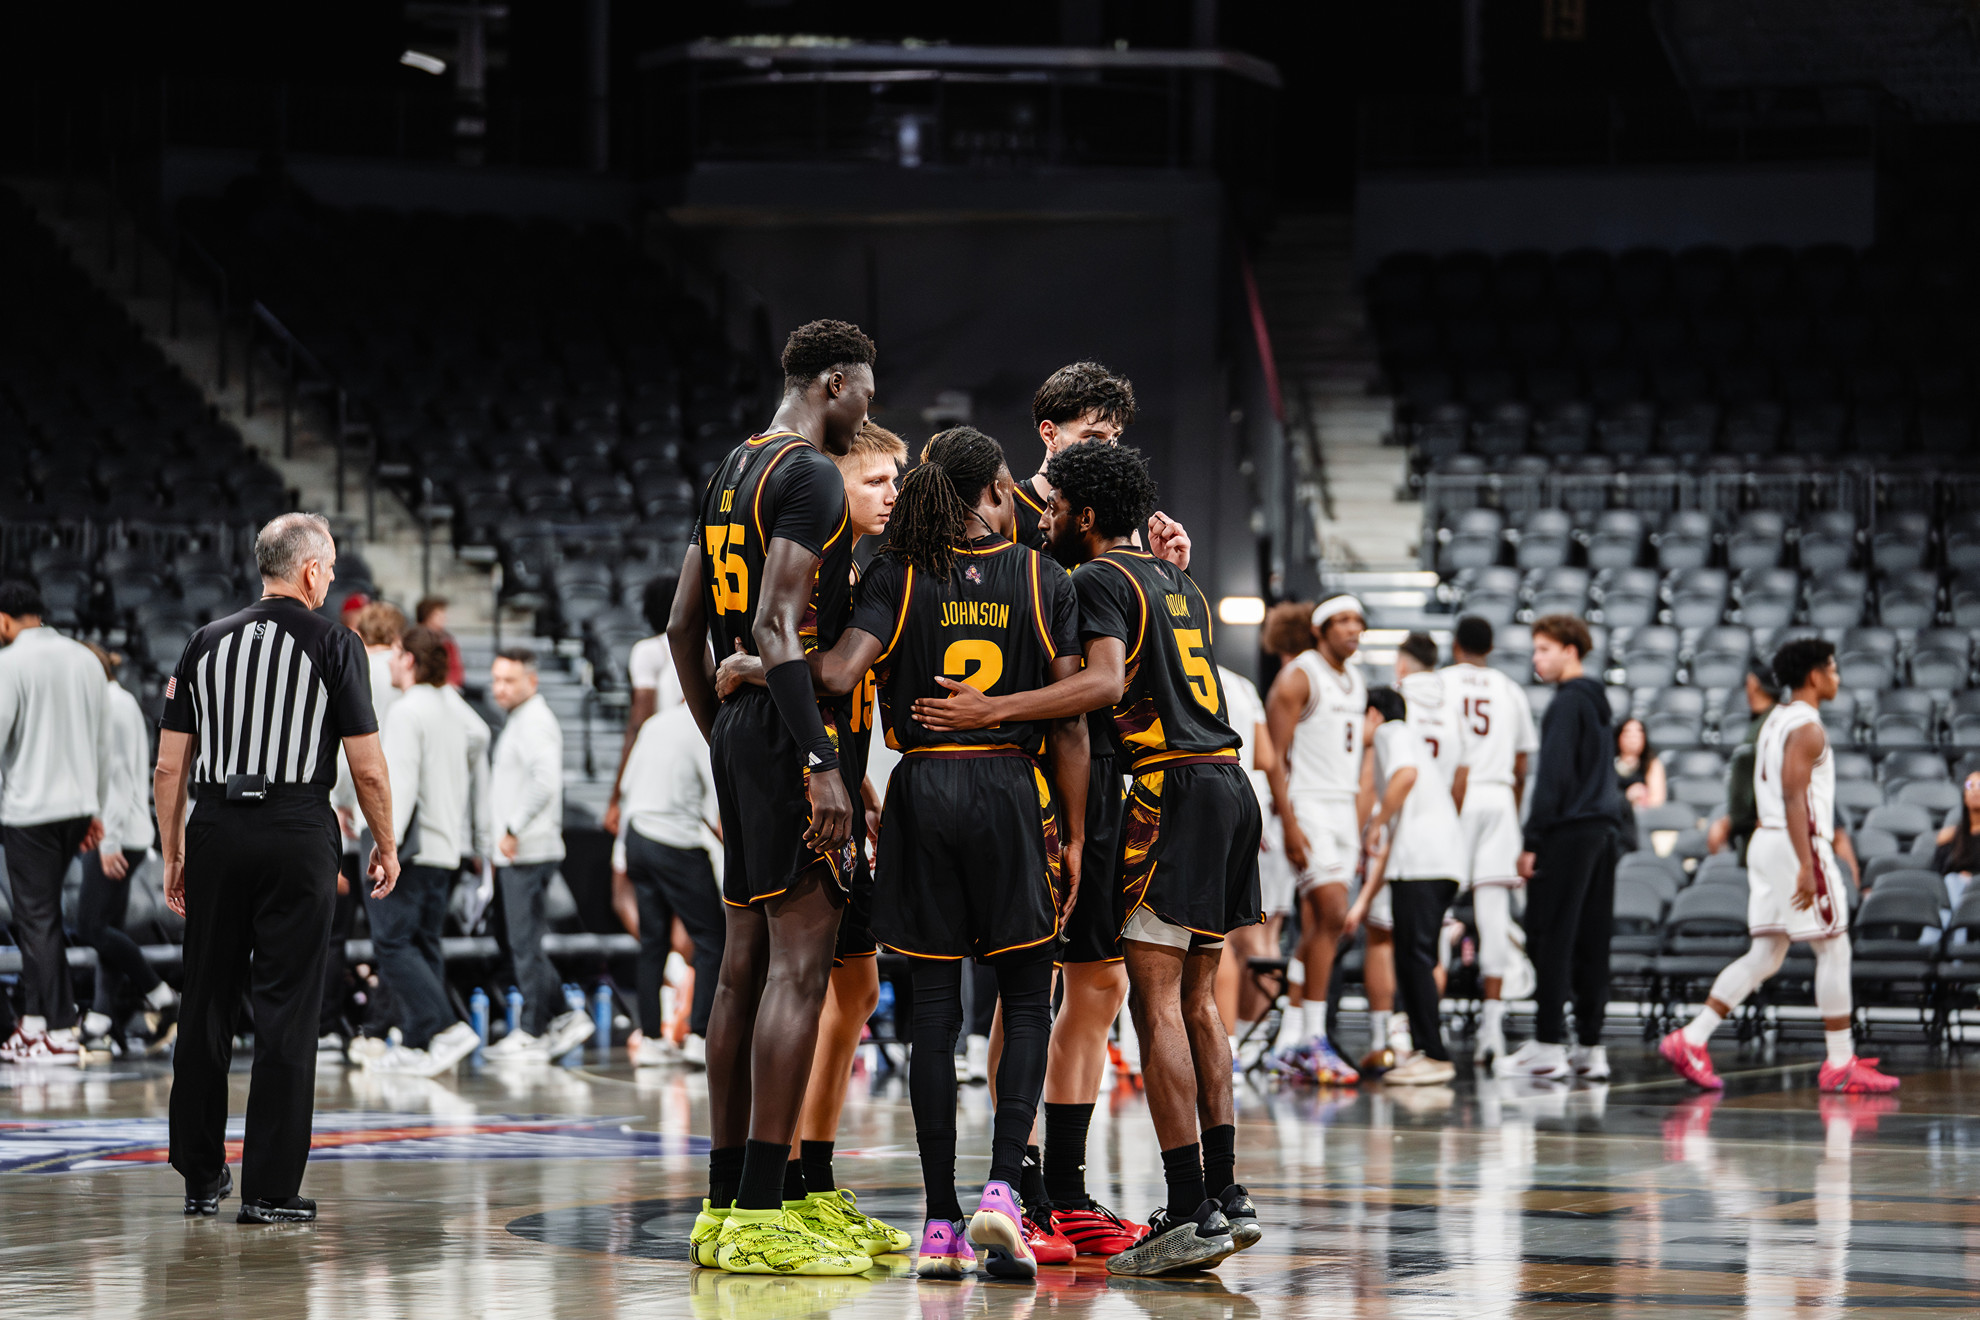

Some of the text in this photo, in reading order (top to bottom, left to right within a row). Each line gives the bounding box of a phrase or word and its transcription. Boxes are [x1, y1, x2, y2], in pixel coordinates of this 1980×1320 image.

[705, 523, 749, 616] 35
[941, 601, 1010, 629] JOHNSON
[943, 639, 1004, 727] 2
[1173, 628, 1219, 715] 5
[1463, 696, 1490, 736] 15
